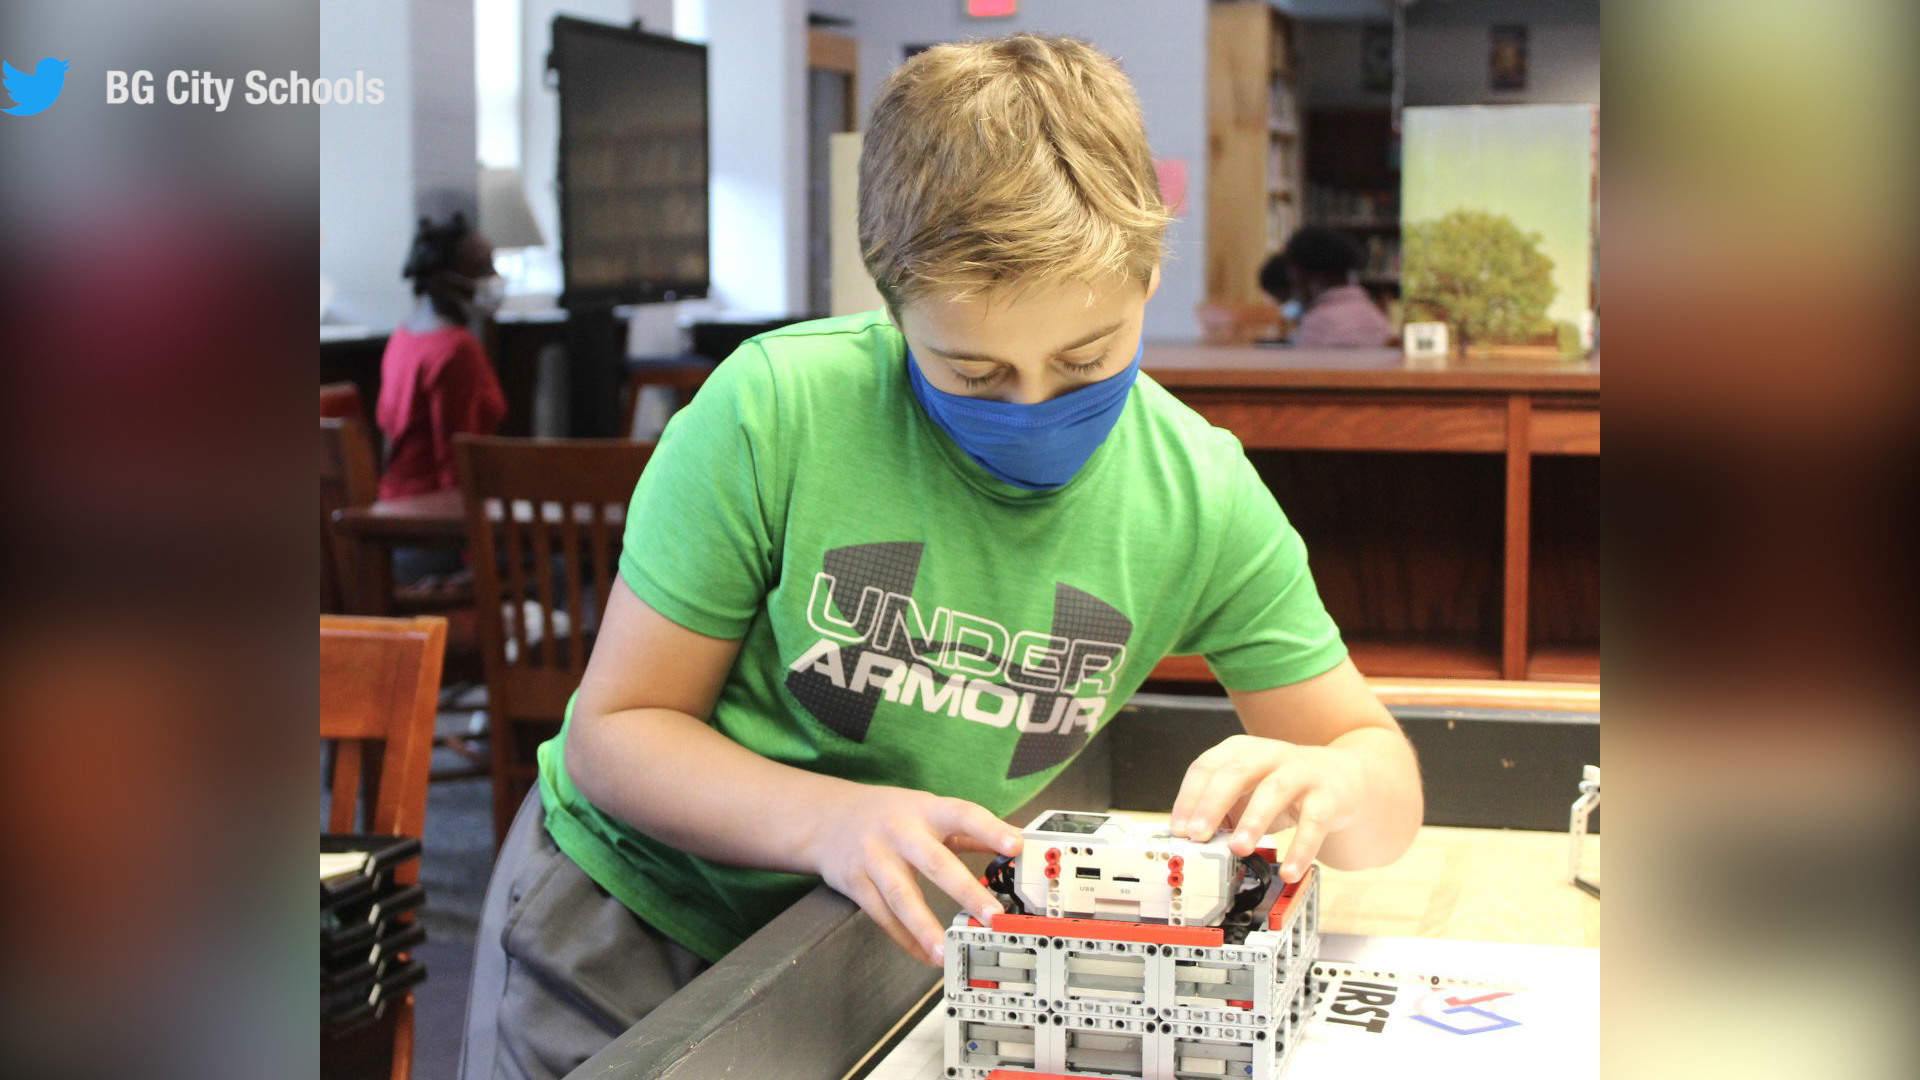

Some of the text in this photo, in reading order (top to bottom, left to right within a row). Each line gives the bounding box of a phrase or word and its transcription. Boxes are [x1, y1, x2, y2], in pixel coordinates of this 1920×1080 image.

[806, 572, 1127, 695] UNDER
[789, 638, 1107, 736] ARMOUR
[1079, 885, 1095, 893] USB
[1324, 980, 1399, 1034] IRST
